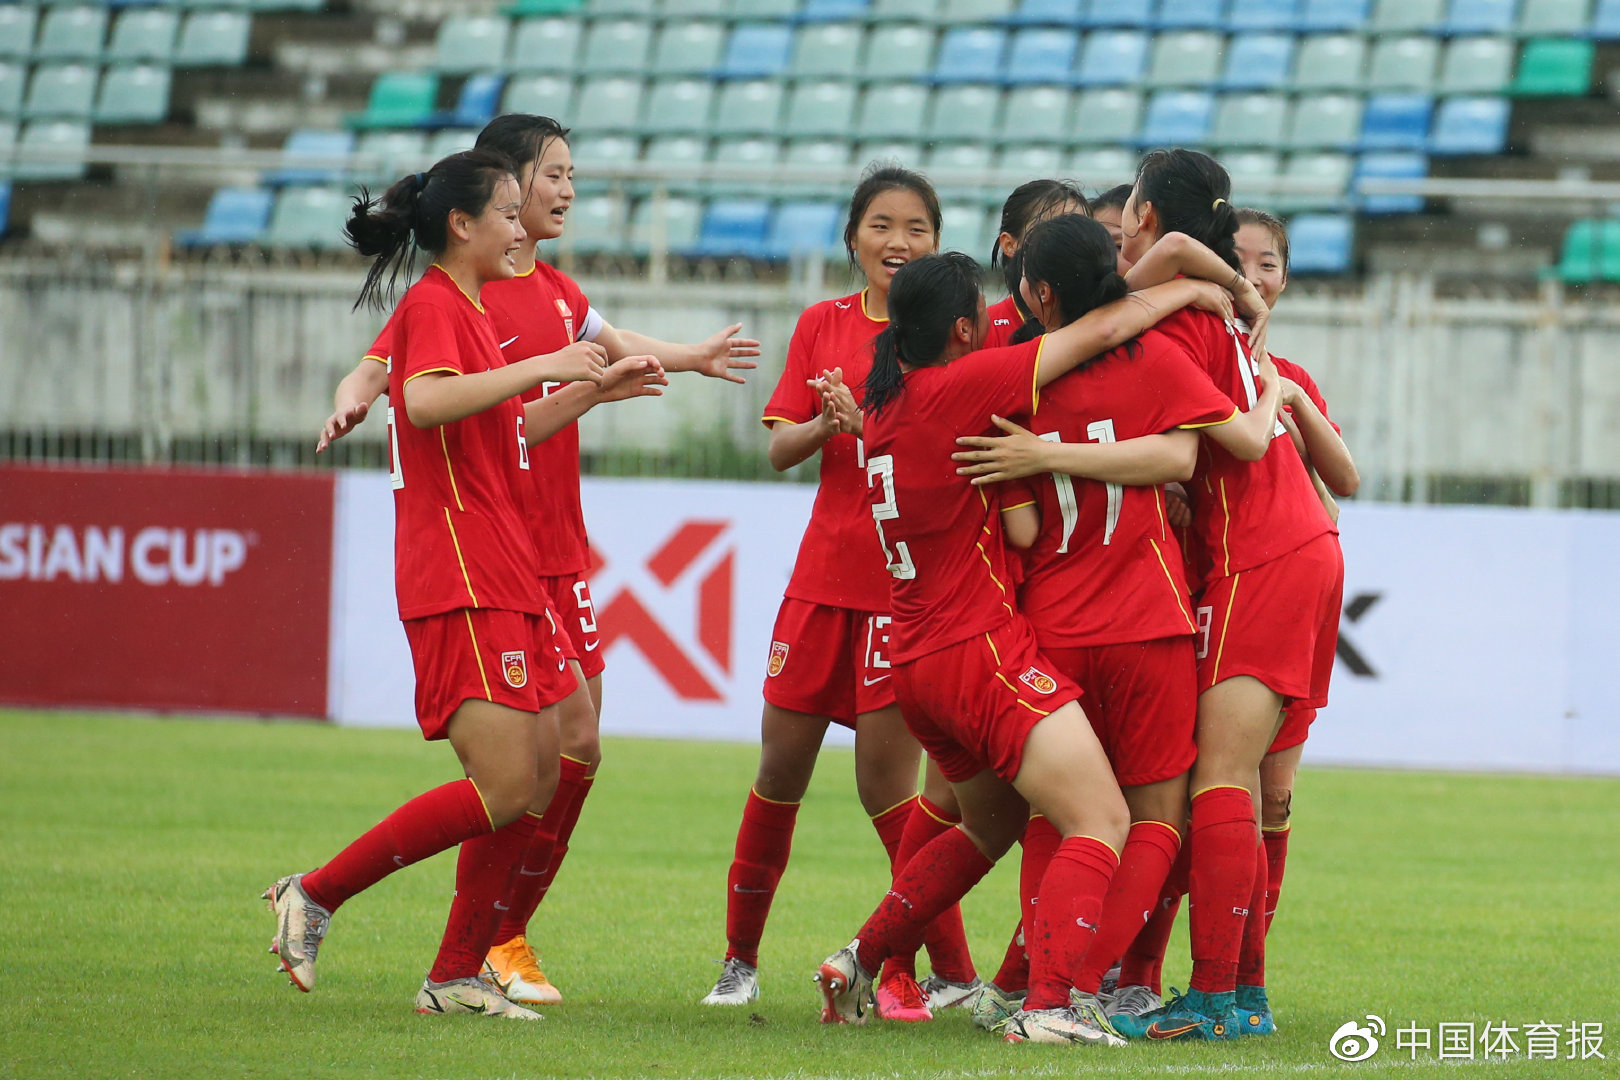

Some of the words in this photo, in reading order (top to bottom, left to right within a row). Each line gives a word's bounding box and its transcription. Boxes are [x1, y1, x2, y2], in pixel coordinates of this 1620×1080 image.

[867, 454, 916, 580] 2
[0, 523, 125, 583] SIAN
[131, 526, 248, 587] CUP
[573, 581, 597, 633] 5
